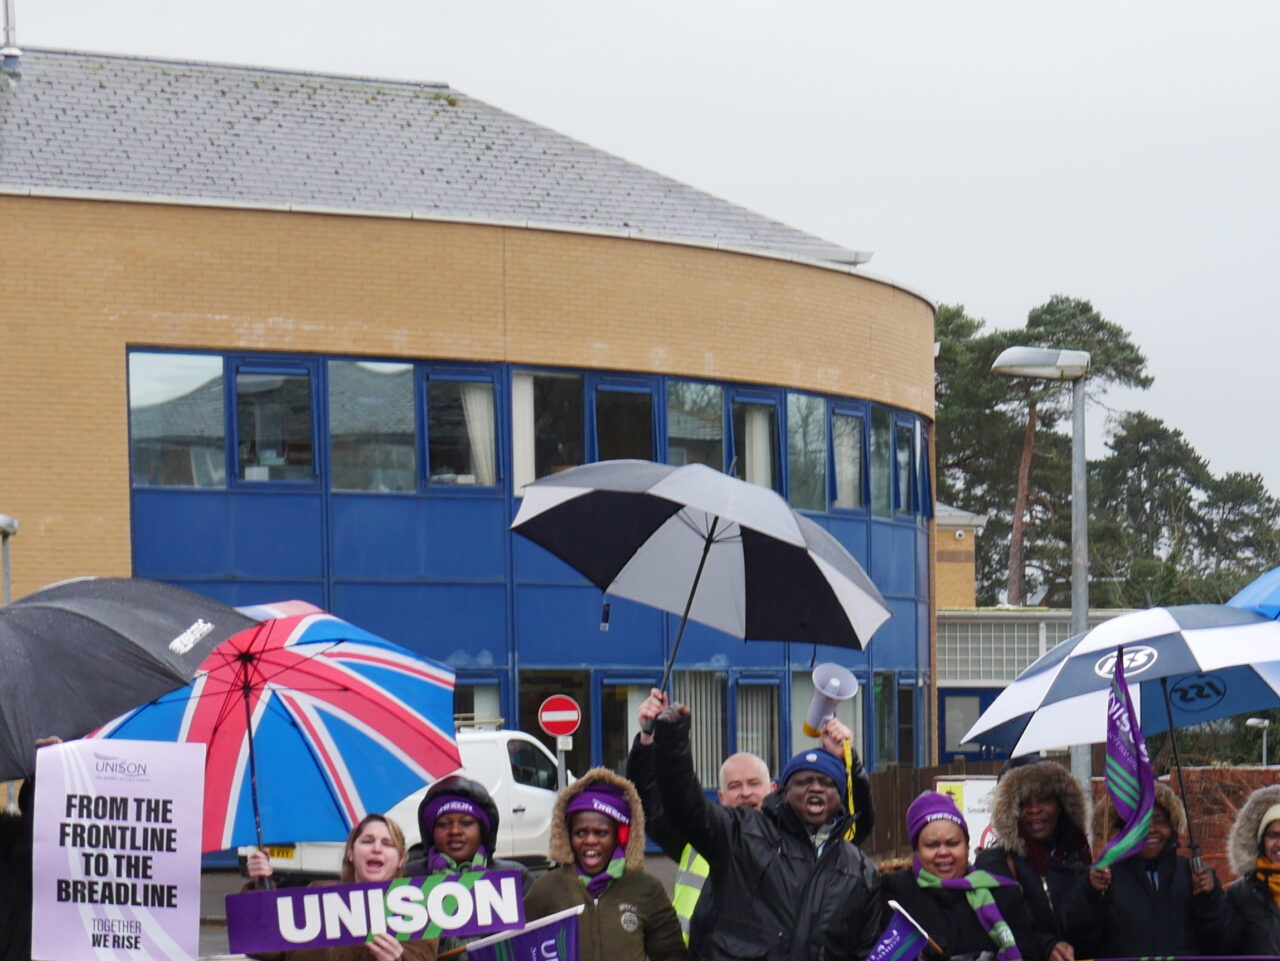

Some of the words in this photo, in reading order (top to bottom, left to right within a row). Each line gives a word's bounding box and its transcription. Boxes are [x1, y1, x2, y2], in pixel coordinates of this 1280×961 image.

[95, 760, 147, 775] UNISON
[66, 794, 129, 821] FROM
[133, 798, 173, 823] THE
[59, 823, 177, 852] FRONTLINE
[82, 853, 109, 877] TO
[113, 854, 153, 880] THE
[57, 879, 177, 908] BREADLINE
[276, 877, 519, 943] UNISON
[92, 918, 142, 934] TOGETHER
[92, 934, 109, 948] WE
[112, 935, 141, 949] RISE
